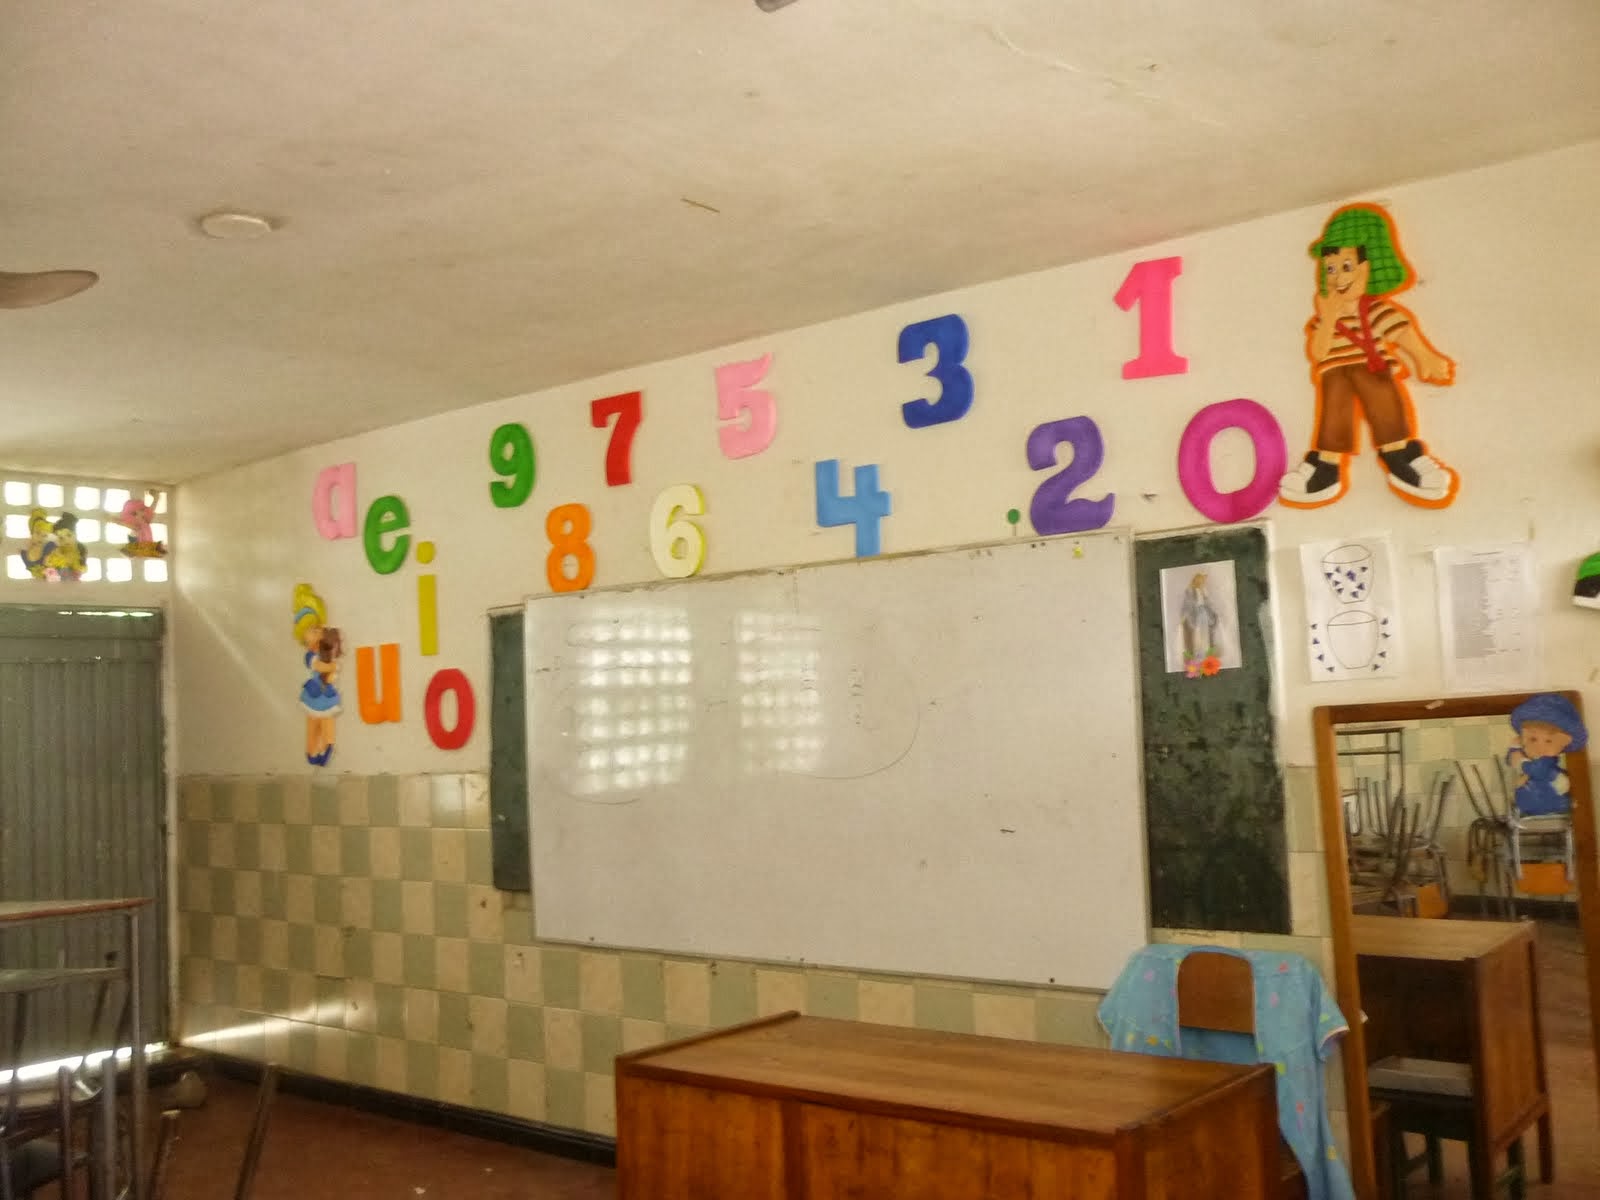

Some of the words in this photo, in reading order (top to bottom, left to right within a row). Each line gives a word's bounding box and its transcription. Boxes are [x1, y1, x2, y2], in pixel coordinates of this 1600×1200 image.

[1113, 255, 1189, 380] 1
[714, 352, 777, 460] 5
[897, 313, 974, 429] 3
[489, 422, 536, 508] 9
[591, 391, 642, 487] 7
[1026, 415, 1115, 536] 2
[312, 462, 356, 540] a
[364, 495, 411, 575] e
[545, 503, 595, 593] 8
[650, 483, 706, 578] 6
[814, 459, 892, 558] 4
[416, 541, 439, 656] i
[355, 643, 402, 725] u
[424, 668, 476, 750] o
